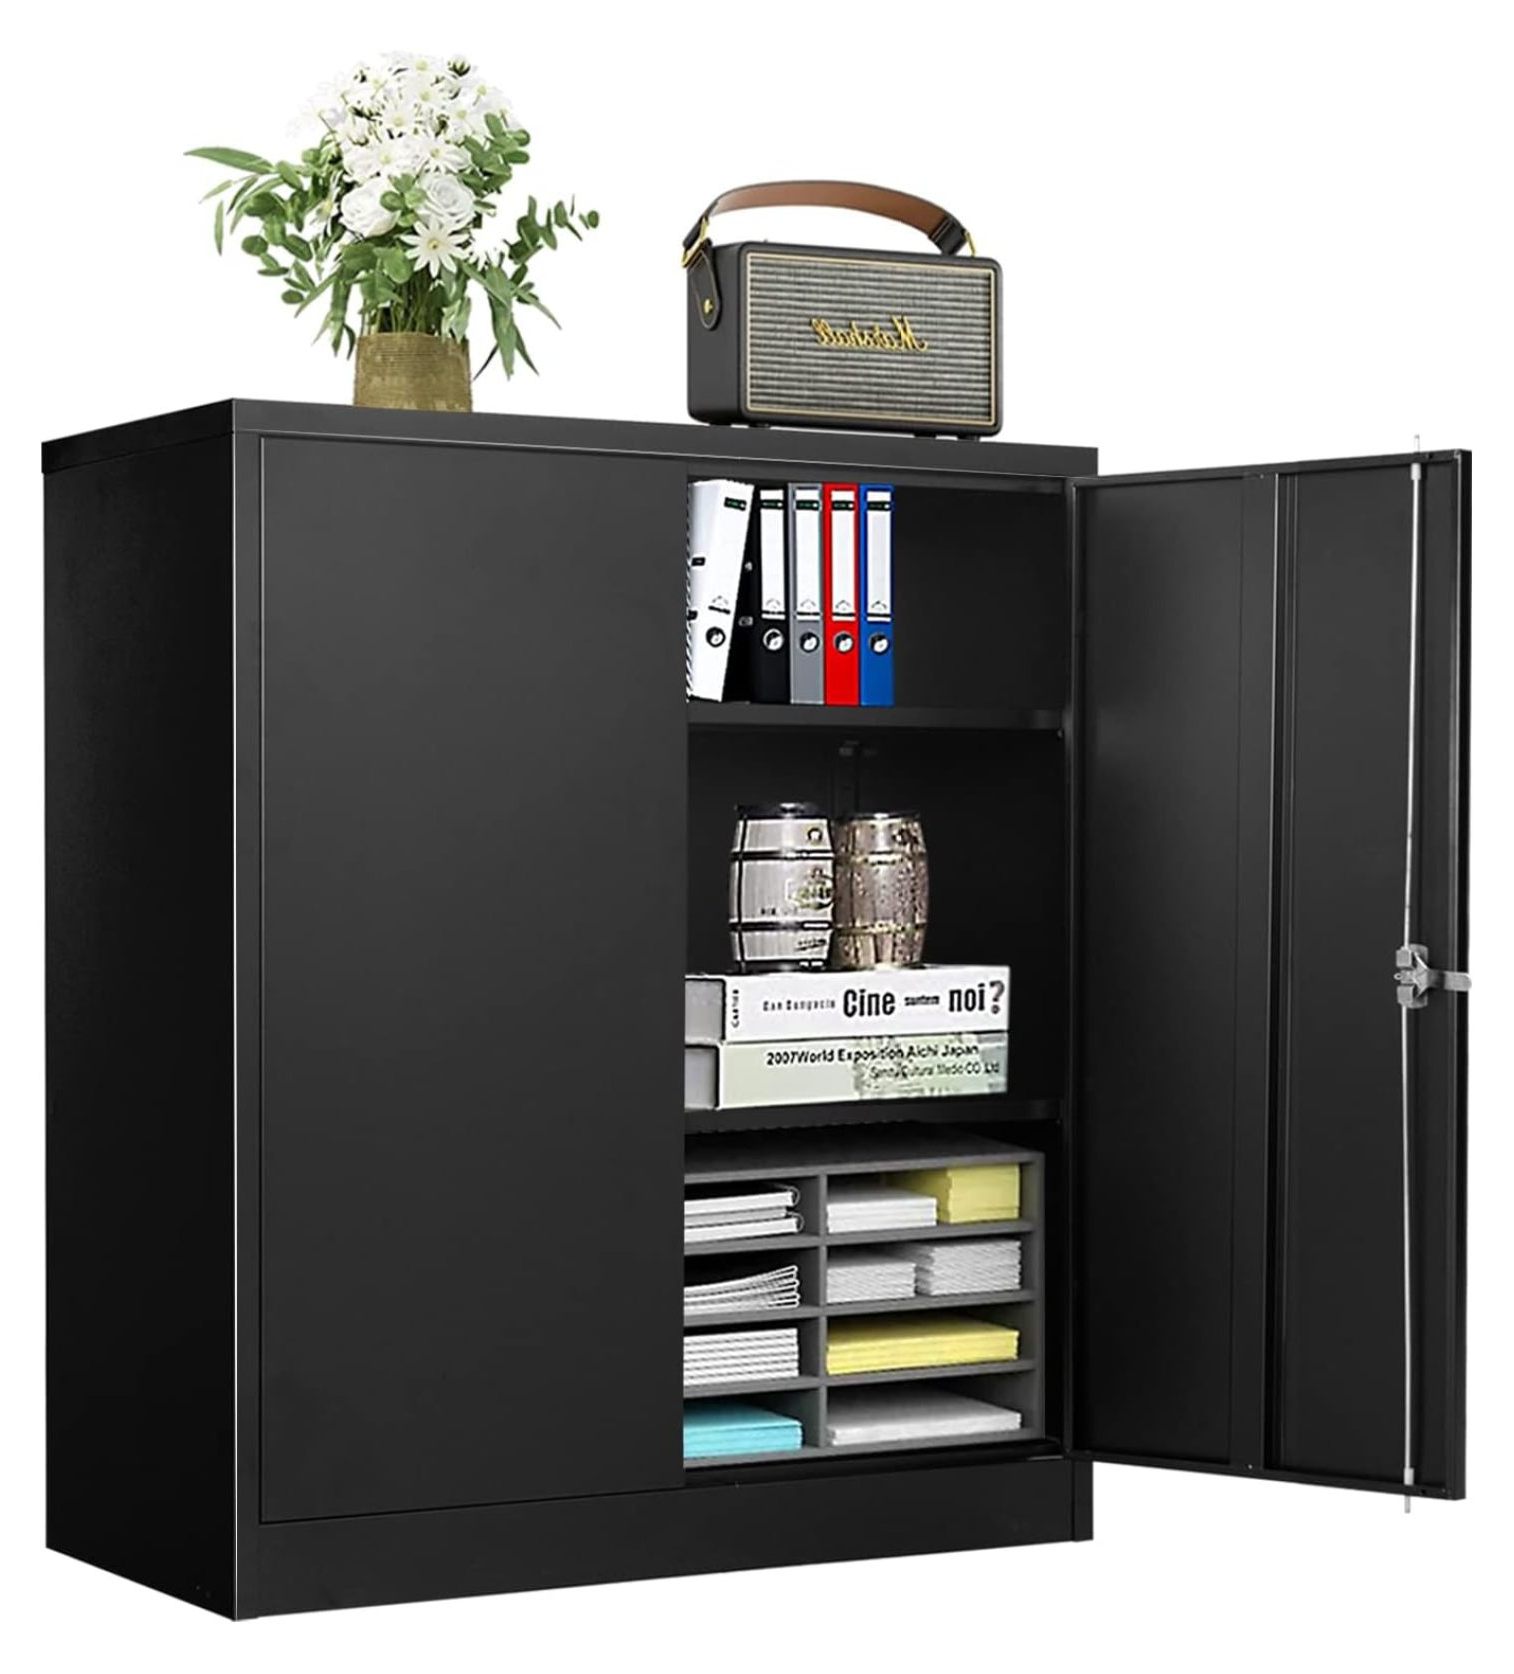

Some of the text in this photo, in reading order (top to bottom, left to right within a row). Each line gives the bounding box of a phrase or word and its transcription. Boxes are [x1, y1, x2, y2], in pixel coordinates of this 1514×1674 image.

[843, 988, 896, 1018] Cine
[948, 980, 1006, 1015] noi?
[838, 1047, 903, 1064] Exposition
[941, 1044, 979, 1058] Japan
